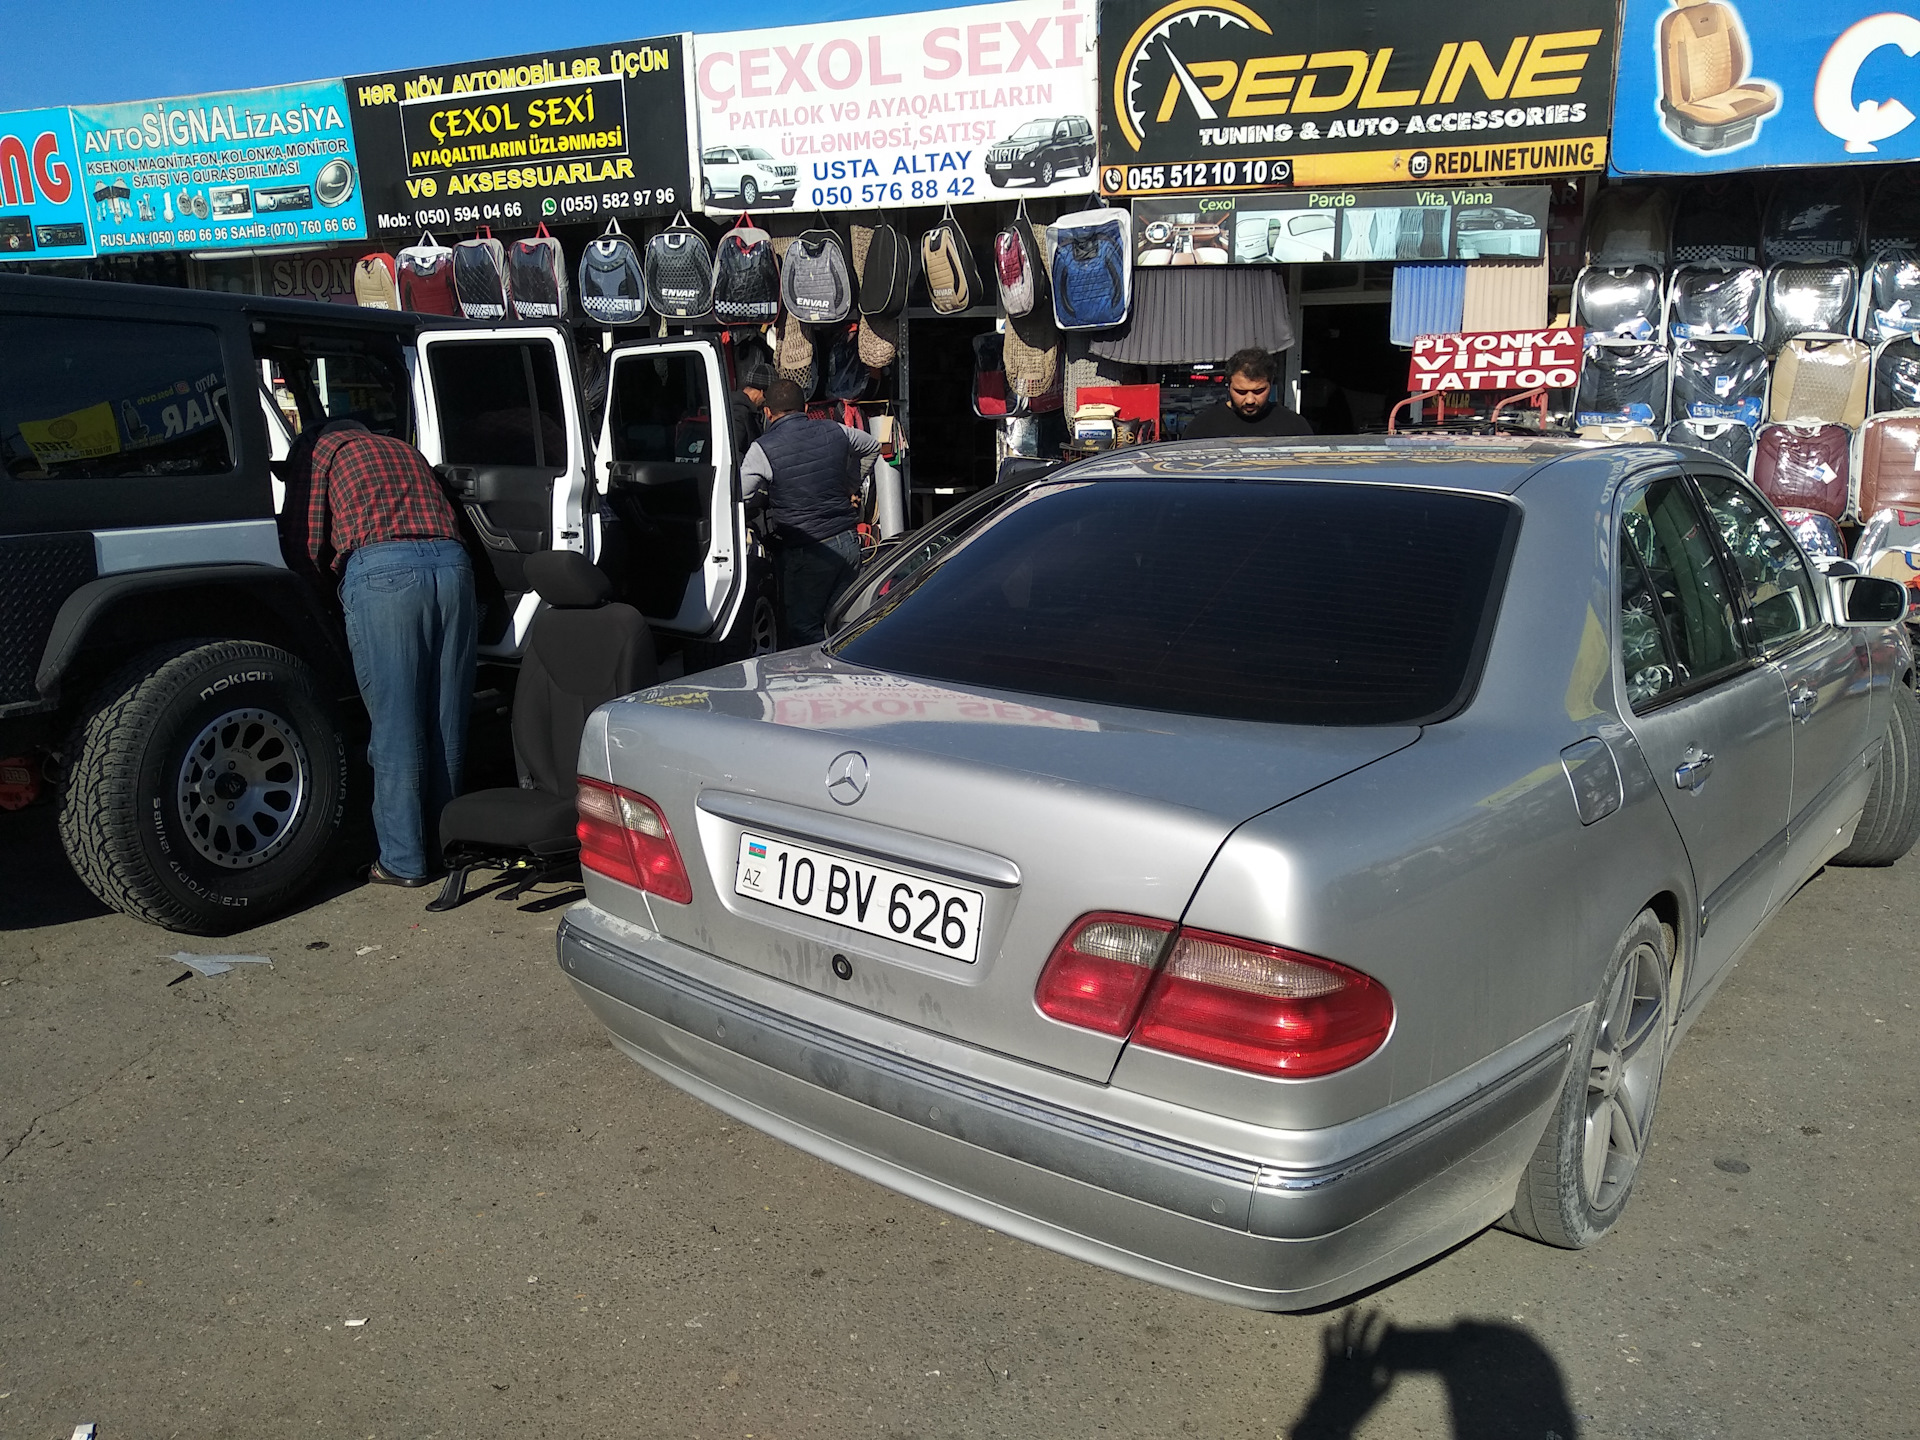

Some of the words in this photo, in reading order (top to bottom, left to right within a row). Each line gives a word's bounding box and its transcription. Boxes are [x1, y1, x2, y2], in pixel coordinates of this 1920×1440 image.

[698, 35, 902, 113] ÇEXOL
[923, 0, 1084, 80] SEXİ
[357, 83, 398, 107] HƏR
[404, 75, 443, 100] NÖV
[452, 57, 602, 94] AVTOMOBİLLƏR
[610, 46, 669, 79] ÜÇÜN
[1155, 29, 1603, 123] REDLINE
[429, 102, 521, 145] ÇEXOL
[527, 87, 595, 129] SEXİ
[729, 102, 824, 130] PATALOK
[830, 102, 860, 121] VƏ
[867, 84, 1053, 120] AYAQALTILARIN
[1198, 123, 1293, 147] TUNING
[1300, 121, 1320, 140] &
[1327, 117, 1400, 140] AUTO
[1405, 103, 1588, 134] ACCESSORIES
[411, 139, 527, 168] AYAQALTILARIN
[529, 126, 623, 154] ÜZLƏNMƏSİ
[132, 171, 170, 189] SATIŞI
[172, 171, 190, 185] VƏ
[192, 161, 300, 184] QURAŞDIRILMASI
[406, 177, 437, 199] VƏ
[447, 158, 635, 195] AKSESSUARLAR
[813, 159, 880, 181] USTA
[892, 150, 973, 175] ALTAY
[1128, 166, 1165, 190] 055
[1170, 163, 1207, 188] 512
[1211, 162, 1237, 185] 10
[1242, 160, 1268, 184] 10
[561, 195, 599, 216] (055)
[602, 191, 630, 210] 582
[632, 190, 652, 206] 97
[656, 187, 675, 204] 96
[811, 186, 853, 206] 050
[861, 183, 903, 204] 576
[911, 180, 939, 200] 88
[942, 176, 975, 197] 42
[1199, 197, 1236, 214] Çexol
[1308, 193, 1356, 208] Pərdə
[1415, 191, 1448, 206] Vita,
[1451, 191, 1493, 206] Viana
[177, 228, 196, 243] 660
[199, 227, 213, 241] 66
[214, 226, 228, 240] 96
[301, 219, 322, 234] 760
[324, 218, 339, 232] 66
[341, 217, 356, 231] 66
[378, 213, 412, 229] Mob:
[414, 208, 450, 228] (050)
[454, 206, 481, 224] 594
[483, 204, 501, 220] 04
[503, 202, 522, 218] 66
[796, 297, 829, 308] ENVAR
[1415, 331, 1576, 354] PLYONKA
[1415, 368, 1577, 390] TATTOO
[742, 867, 761, 888] AZ
[777, 852, 815, 906] 10
[825, 863, 877, 923] BV
[887, 882, 969, 949] 626
